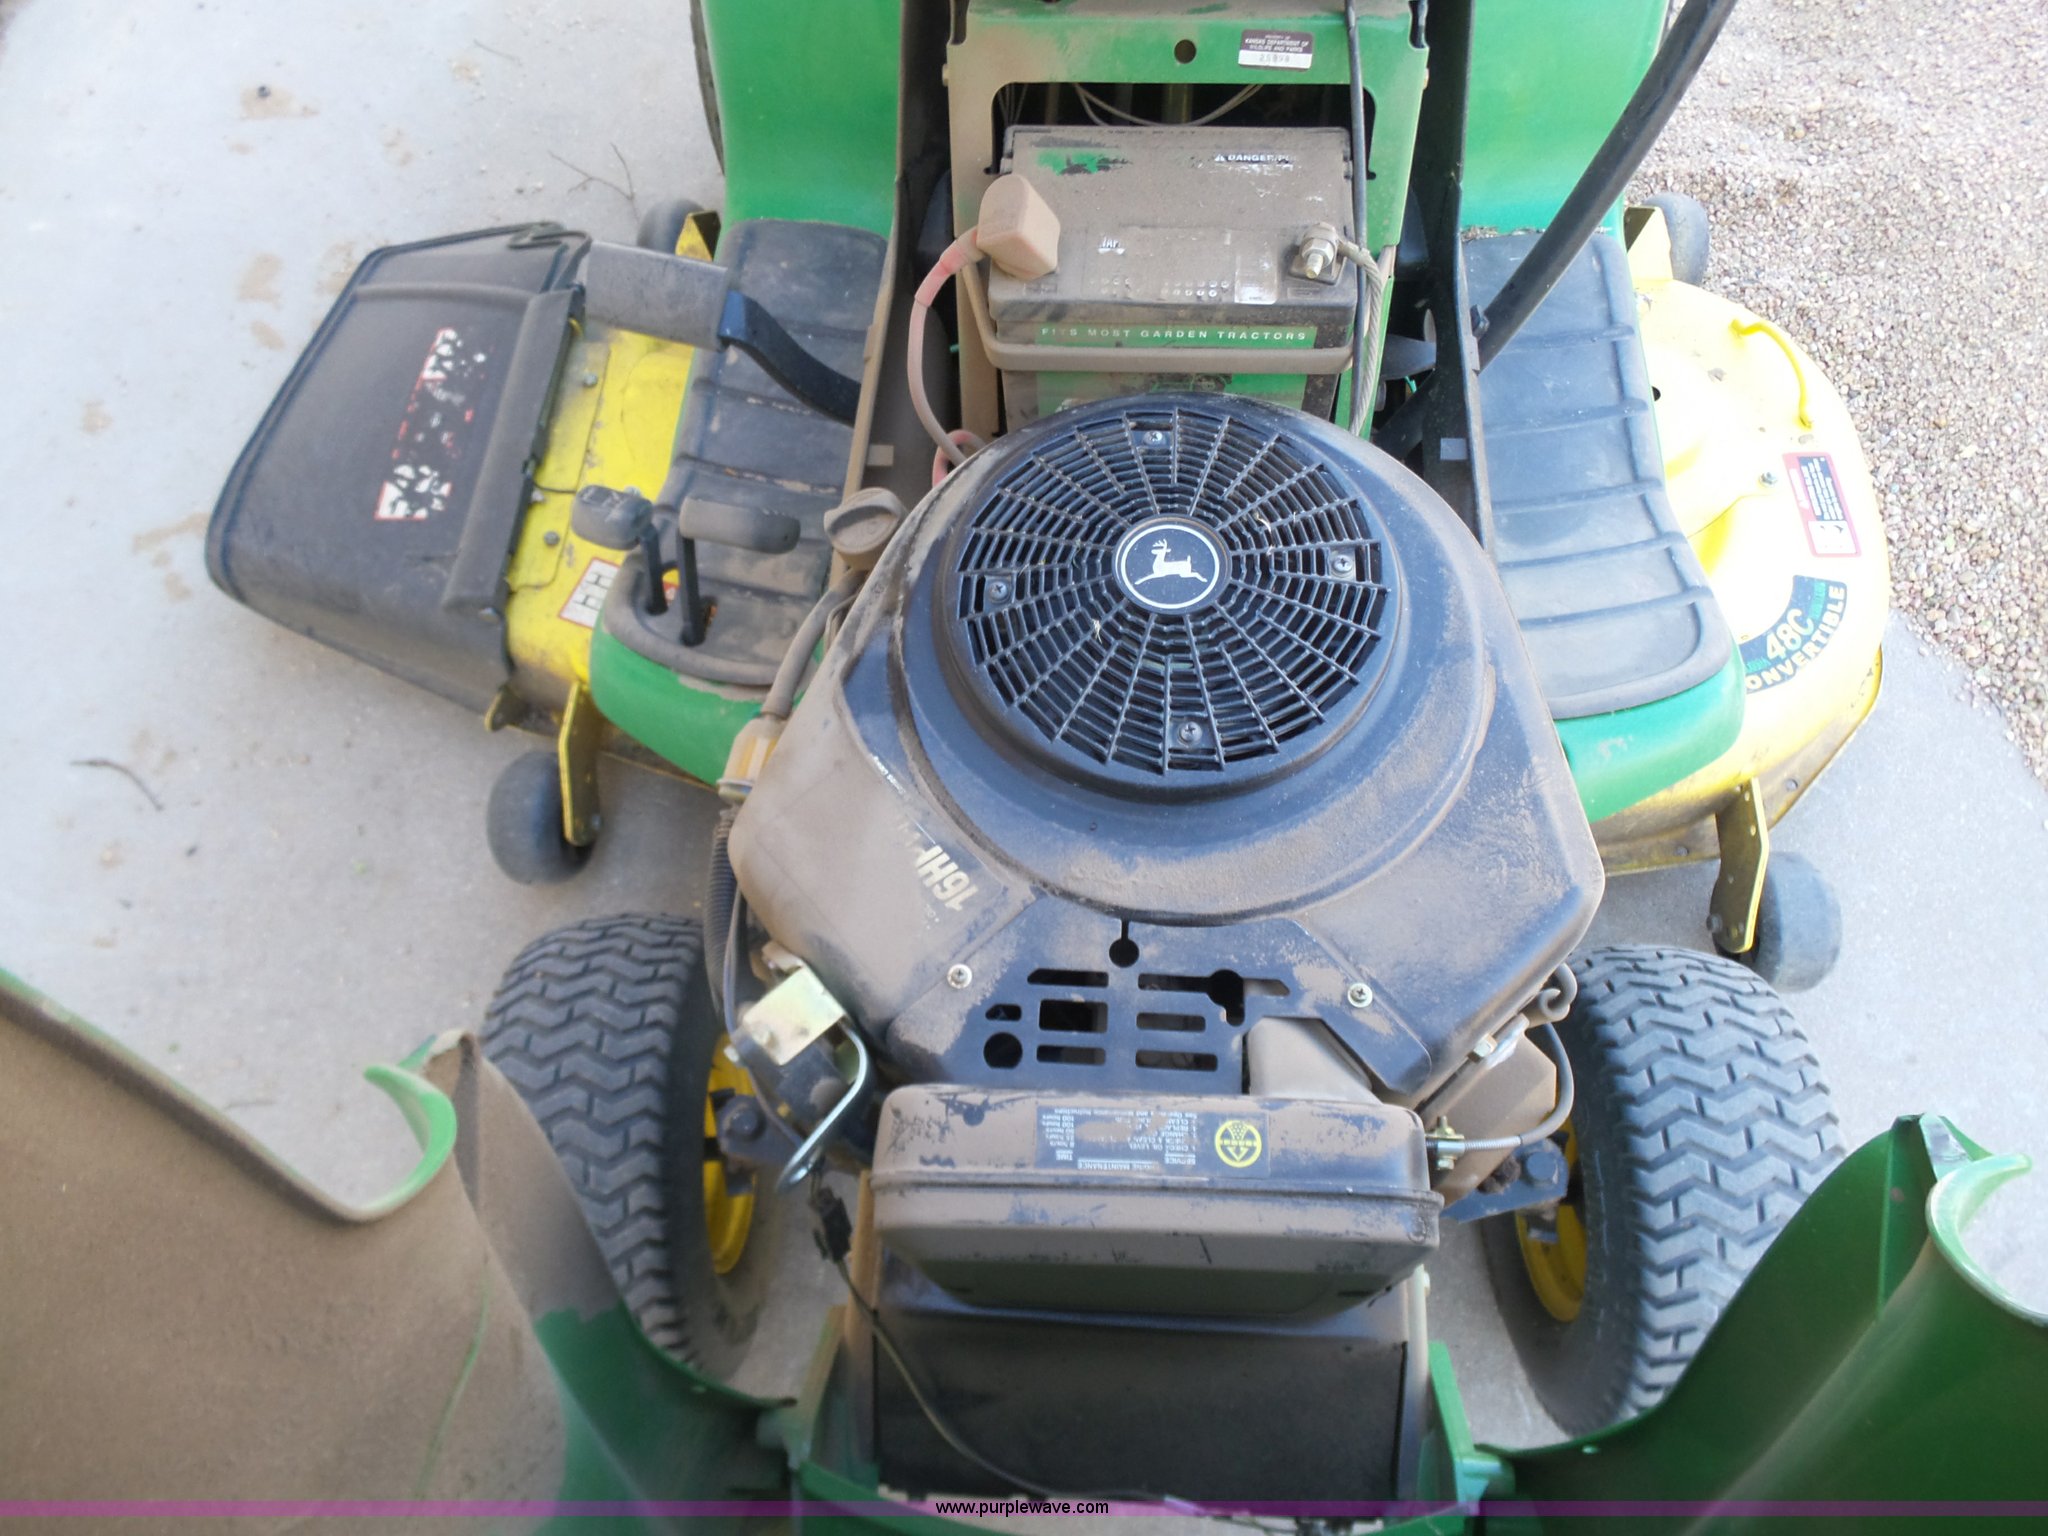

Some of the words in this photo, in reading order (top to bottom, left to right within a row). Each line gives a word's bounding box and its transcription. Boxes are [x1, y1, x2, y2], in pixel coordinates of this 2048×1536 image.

[1088, 329, 1131, 338] MOST
[1140, 330, 1208, 339] GARDEN
[1217, 331, 1306, 341] TRACTORS
[1745, 585, 1845, 689] ONVERTIBLE
[1766, 608, 1815, 660] 48C
[1056, 1152, 1073, 1161] TIME
[1077, 1162, 1130, 1171] MAINTENANCE
